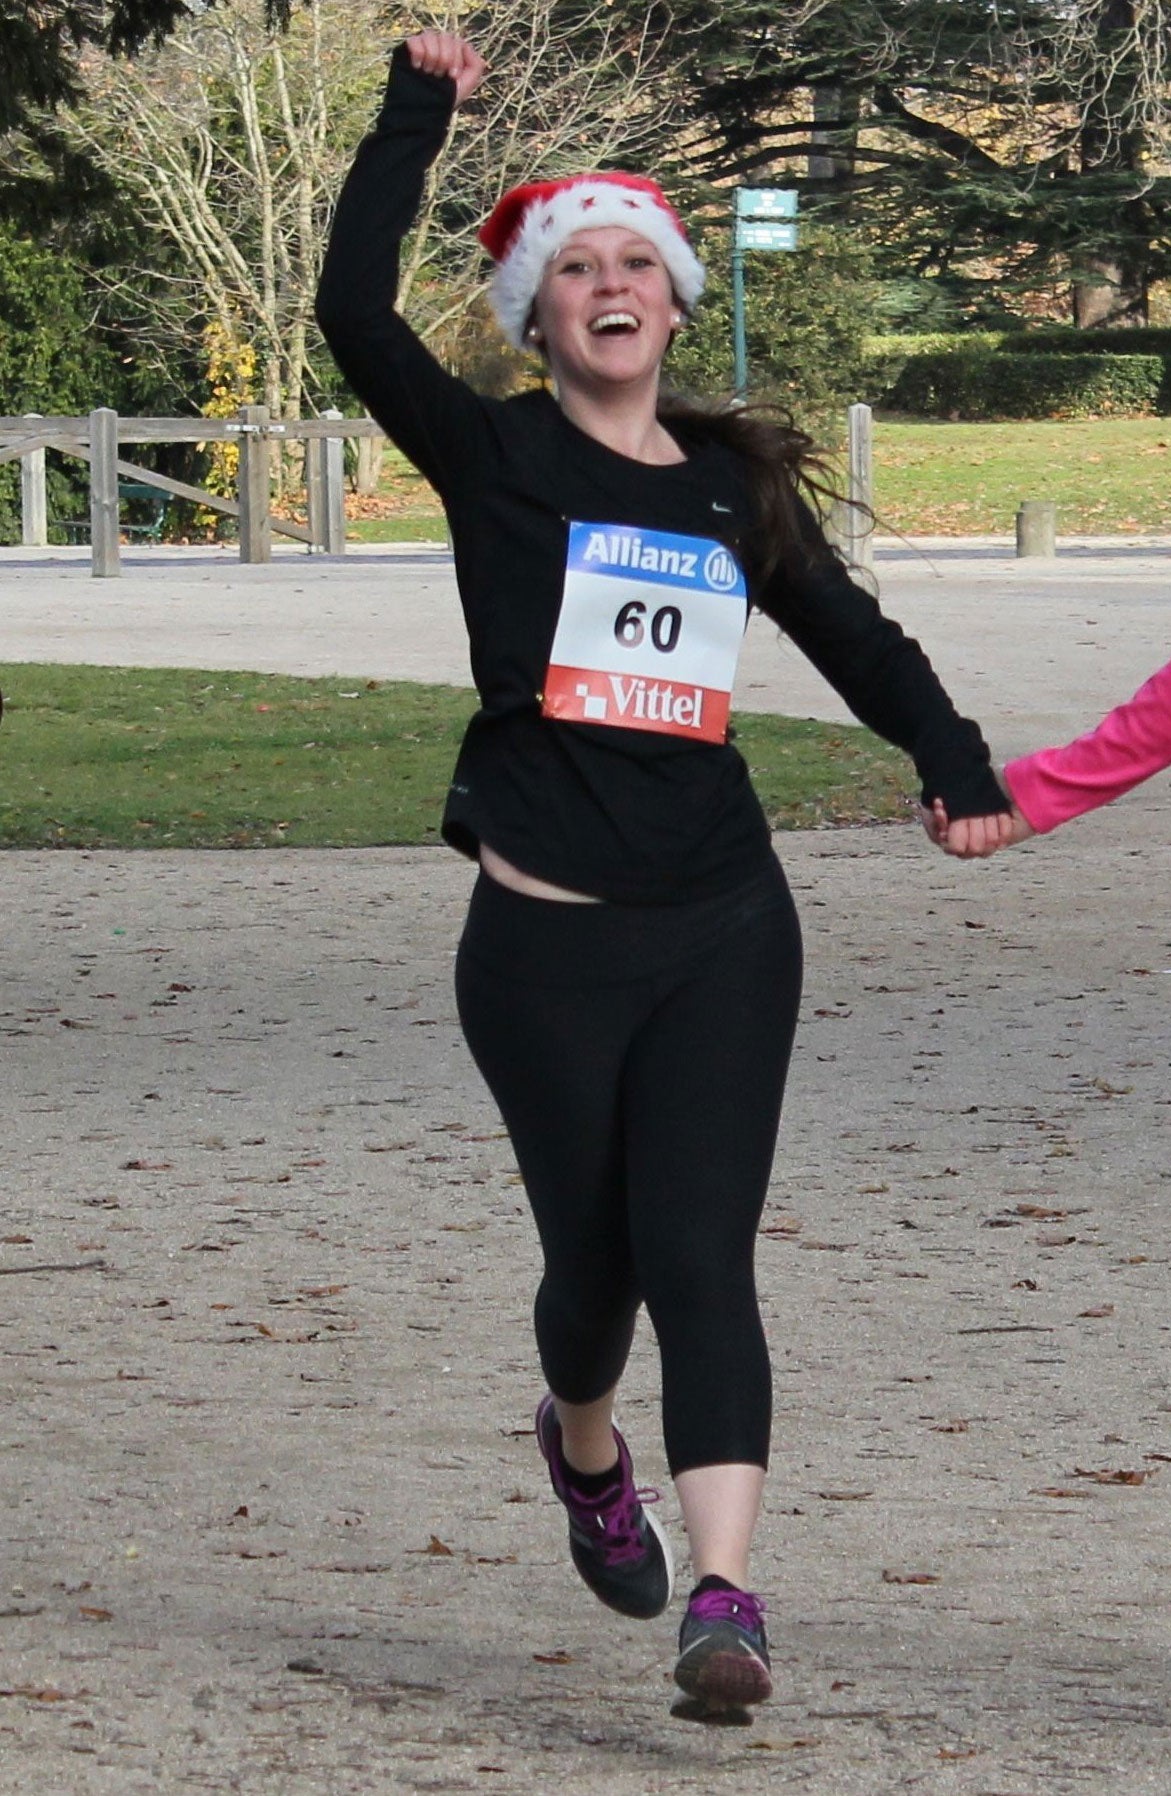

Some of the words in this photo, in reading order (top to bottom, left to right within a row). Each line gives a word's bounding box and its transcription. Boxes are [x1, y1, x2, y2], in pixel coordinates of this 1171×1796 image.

[583, 532, 698, 578] Allianz
[614, 601, 682, 653] 60
[608, 675, 704, 728] Vittel
